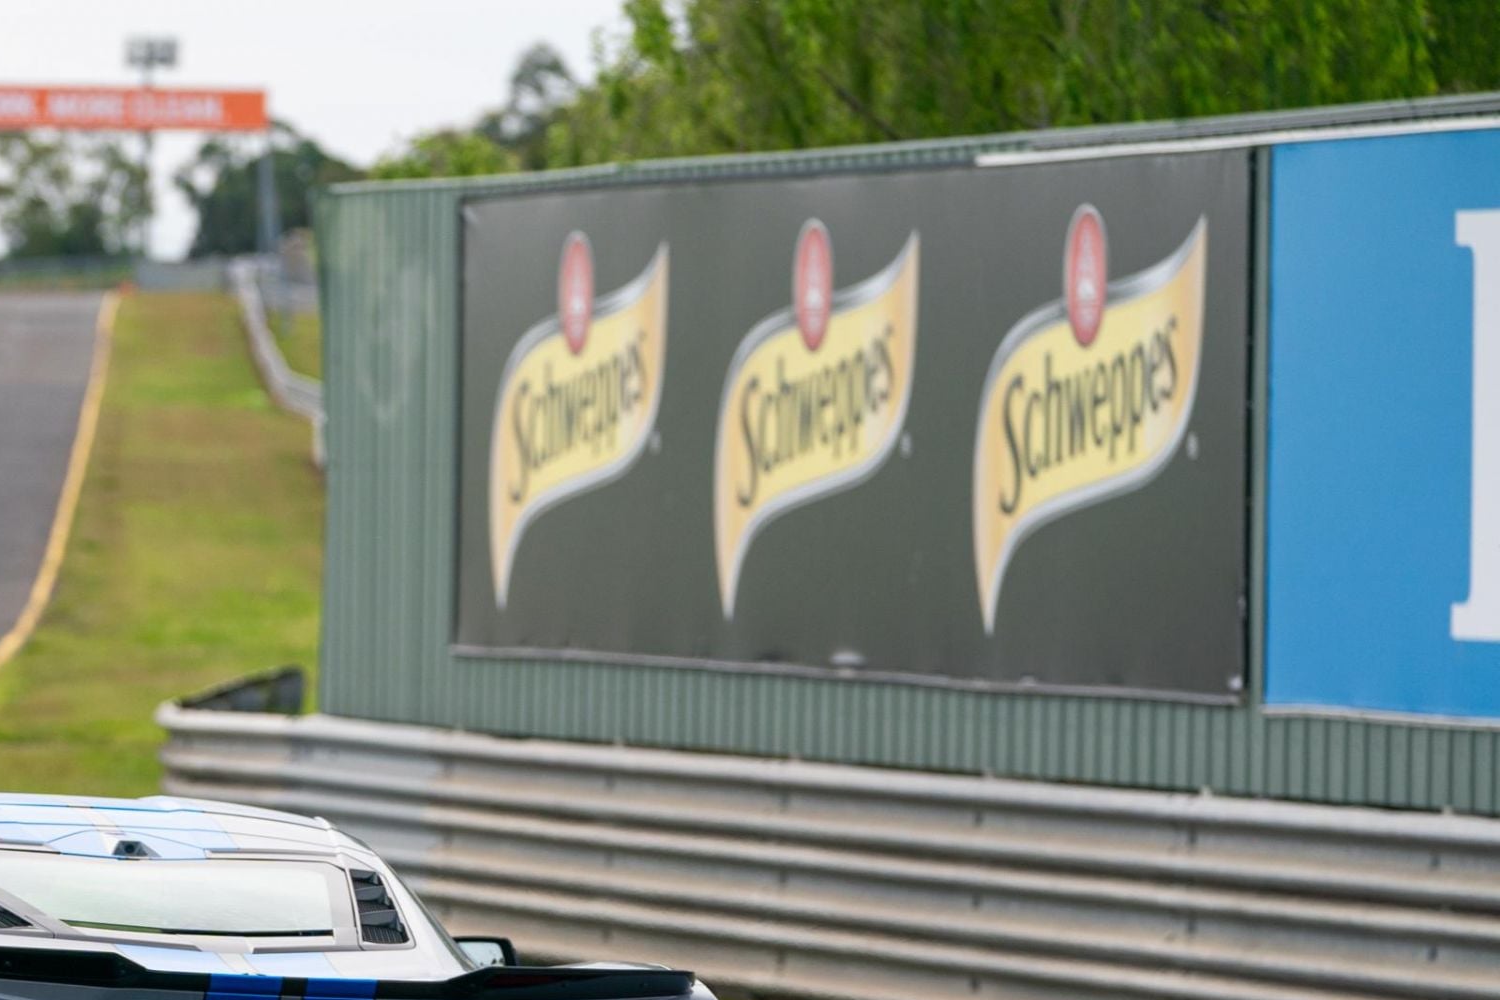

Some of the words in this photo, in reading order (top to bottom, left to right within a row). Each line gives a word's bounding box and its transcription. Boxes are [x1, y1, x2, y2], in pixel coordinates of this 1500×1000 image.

[509, 330, 649, 502] Schweppes
[737, 323, 895, 508] Schweppes
[999, 315, 1177, 516] Schweppes
